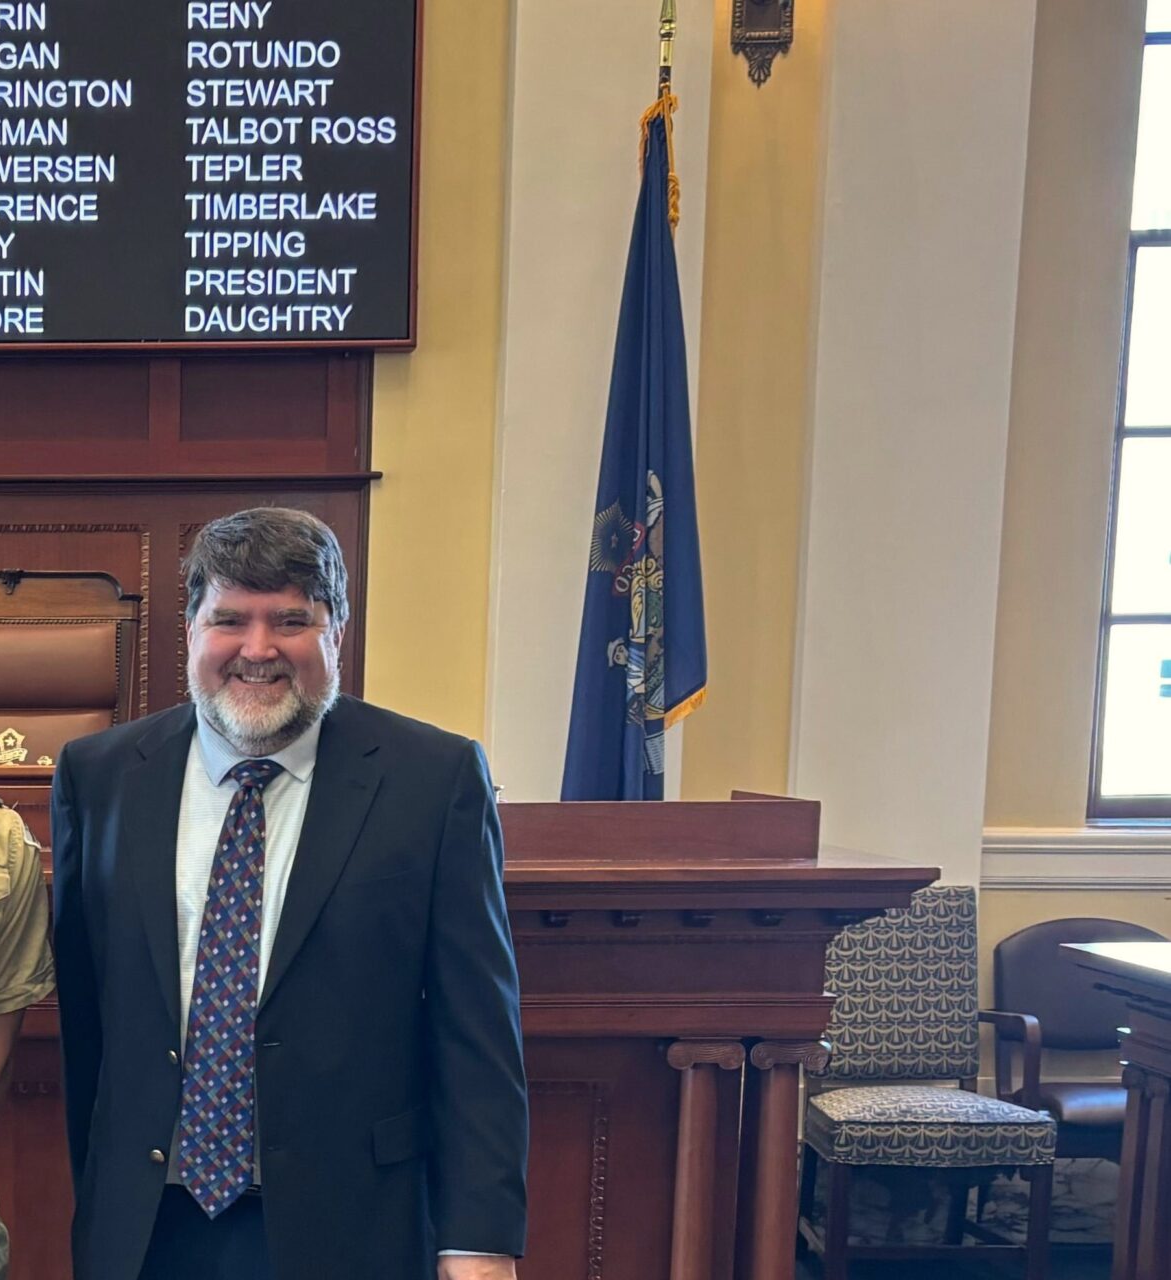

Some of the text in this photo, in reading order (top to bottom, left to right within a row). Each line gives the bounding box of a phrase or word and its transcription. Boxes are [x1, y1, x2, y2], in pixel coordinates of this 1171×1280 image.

[188, 2, 272, 29] RENY
[188, 41, 340, 68] ROTUNDO
[187, 79, 333, 107] STEWART
[186, 117, 396, 144] TALBOT ROSS
[185, 155, 303, 182] TEPLER
[185, 193, 376, 220] TIMBERLAKE
[185, 231, 305, 258] TIPPING
[185, 269, 357, 295] PRESIDENT
[185, 305, 352, 332] DAUGHTRY
